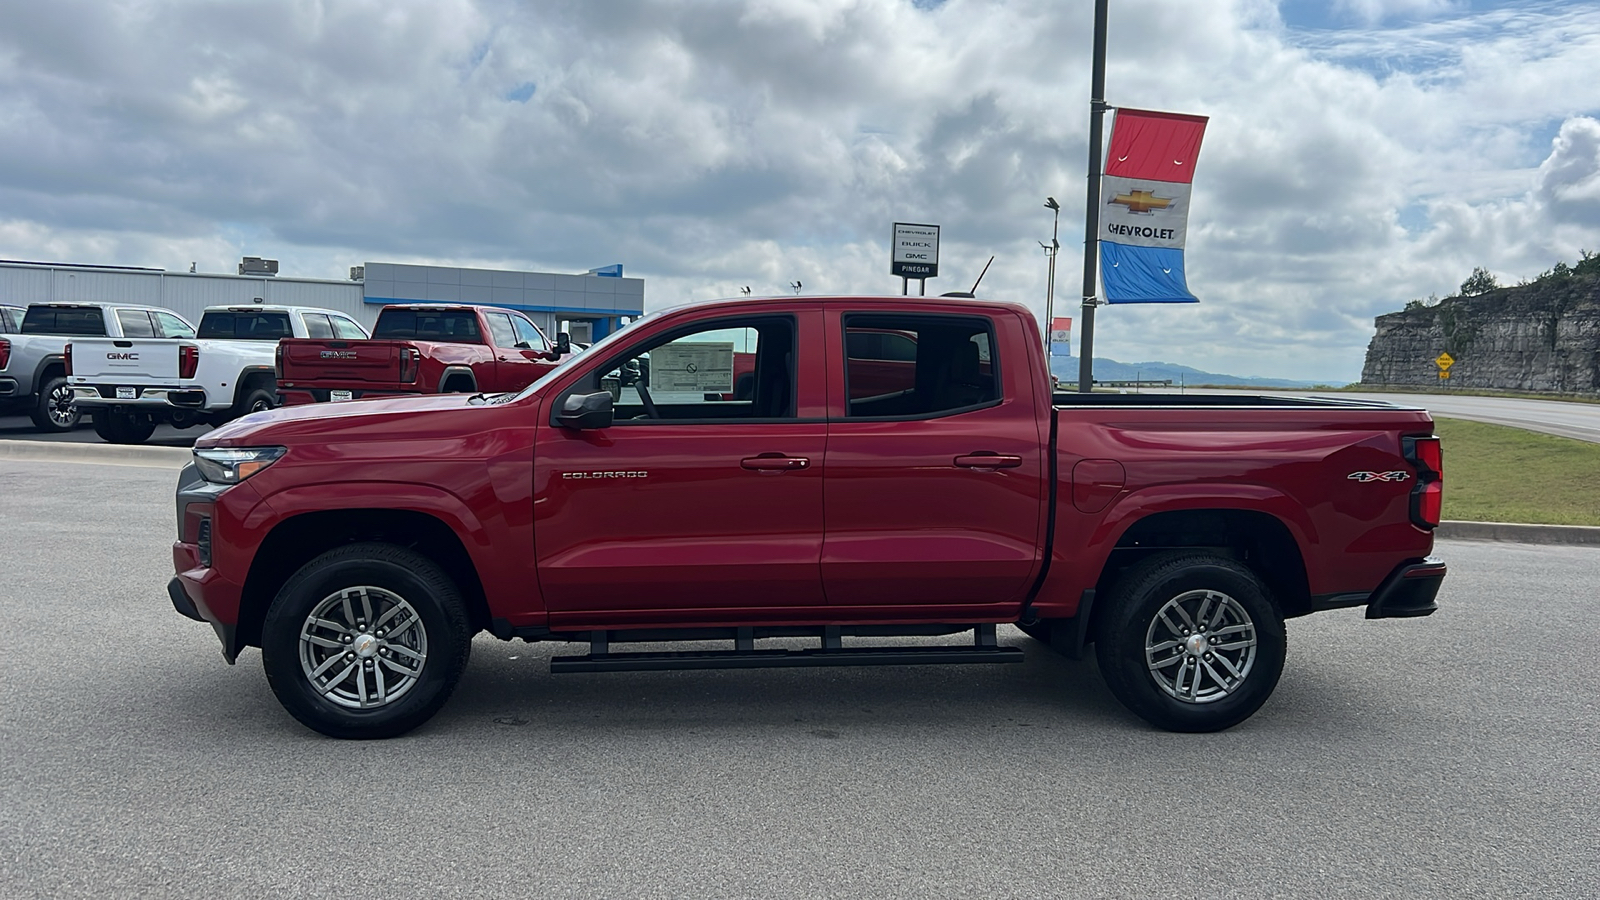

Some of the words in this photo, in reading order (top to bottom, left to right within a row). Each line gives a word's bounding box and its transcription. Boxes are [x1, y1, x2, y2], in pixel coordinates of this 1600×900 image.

[1108, 222, 1174, 240] CHEVROLET
[901, 265, 930, 273] PINEGAR
[106, 352, 139, 360] GMC
[320, 350, 357, 359] GMC
[562, 471, 648, 480] COLORADO
